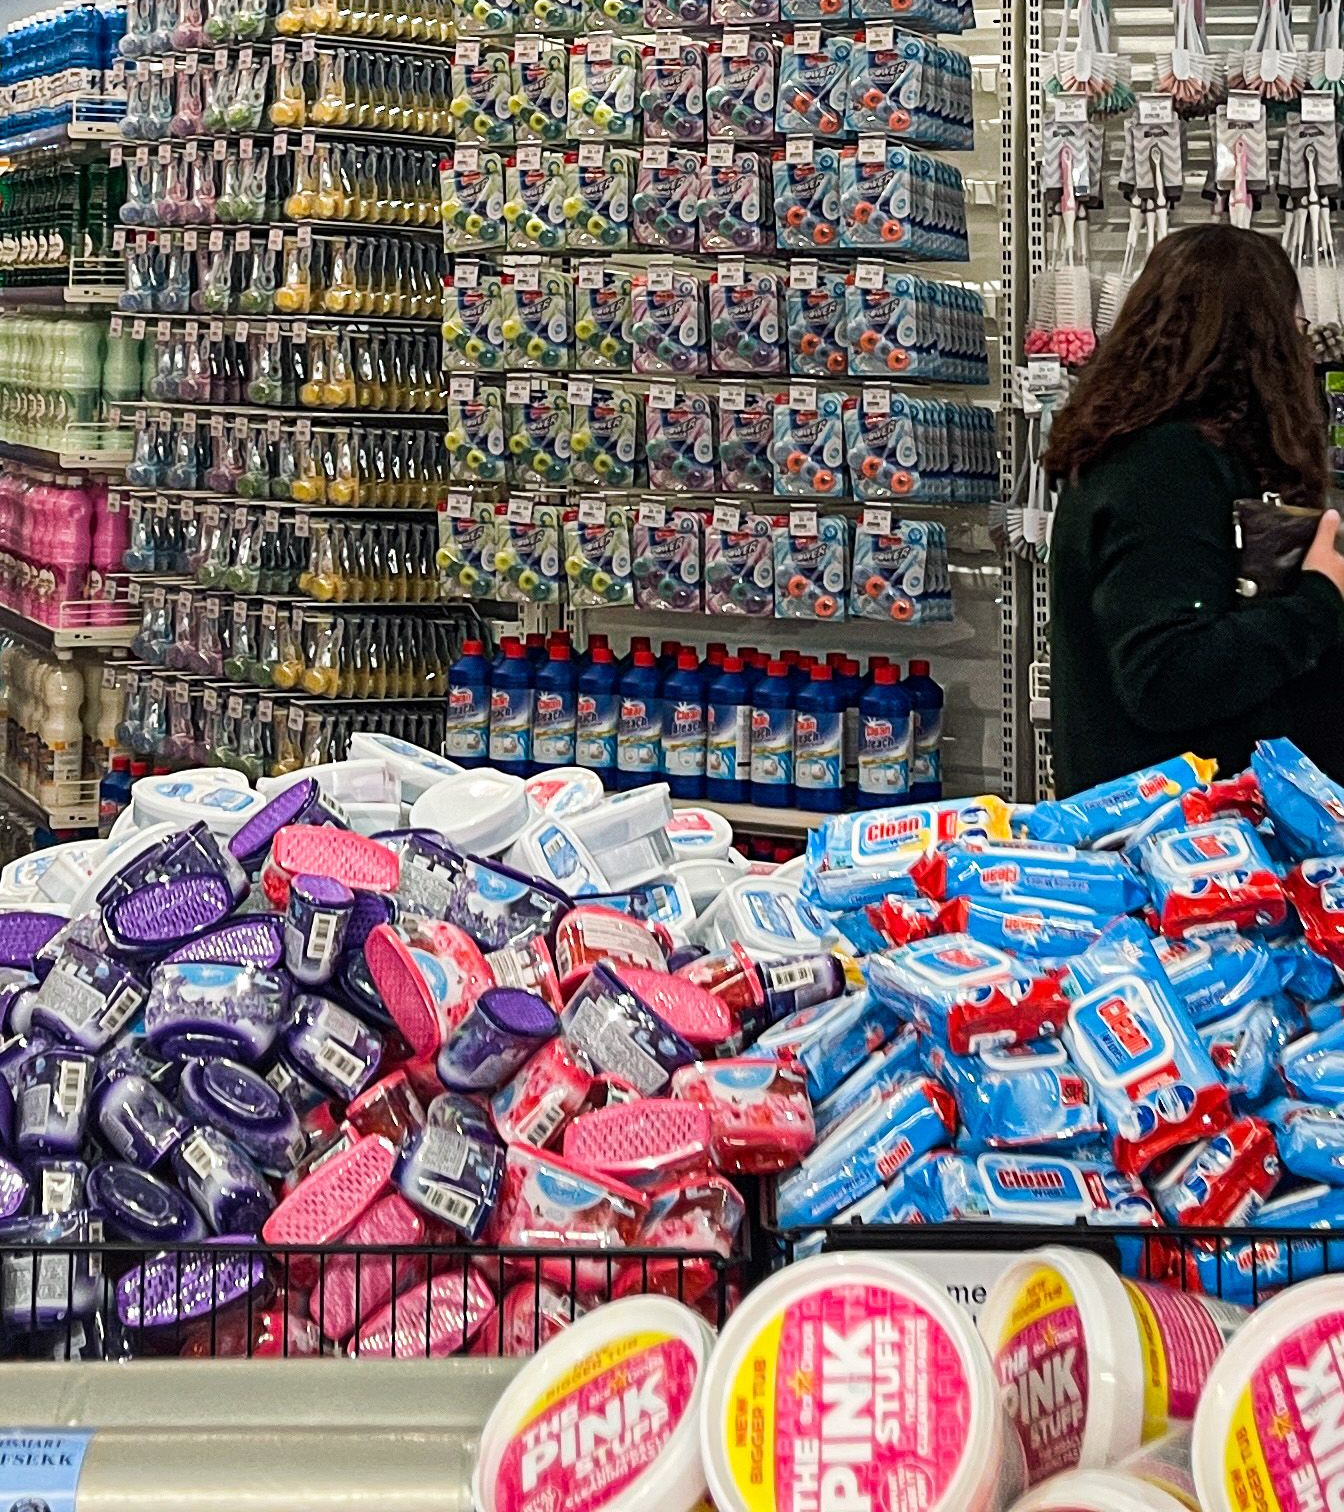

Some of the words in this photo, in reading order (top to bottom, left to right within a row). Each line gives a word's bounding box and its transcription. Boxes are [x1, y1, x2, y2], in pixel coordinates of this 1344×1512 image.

[867, 816, 920, 843] Clean
[997, 1168, 1065, 1189] Clean
[946, 1283, 987, 1304] me
[874, 1317, 900, 1446] STUFF
[1000, 1345, 1028, 1383] THE
[1001, 1347, 1081, 1426] PINK
[521, 1370, 669, 1493] PINK
[523, 1404, 579, 1449] THE
[821, 1320, 873, 1512] PINK
[1030, 1394, 1085, 1450] STUFF
[792, 1437, 820, 1512] THE
